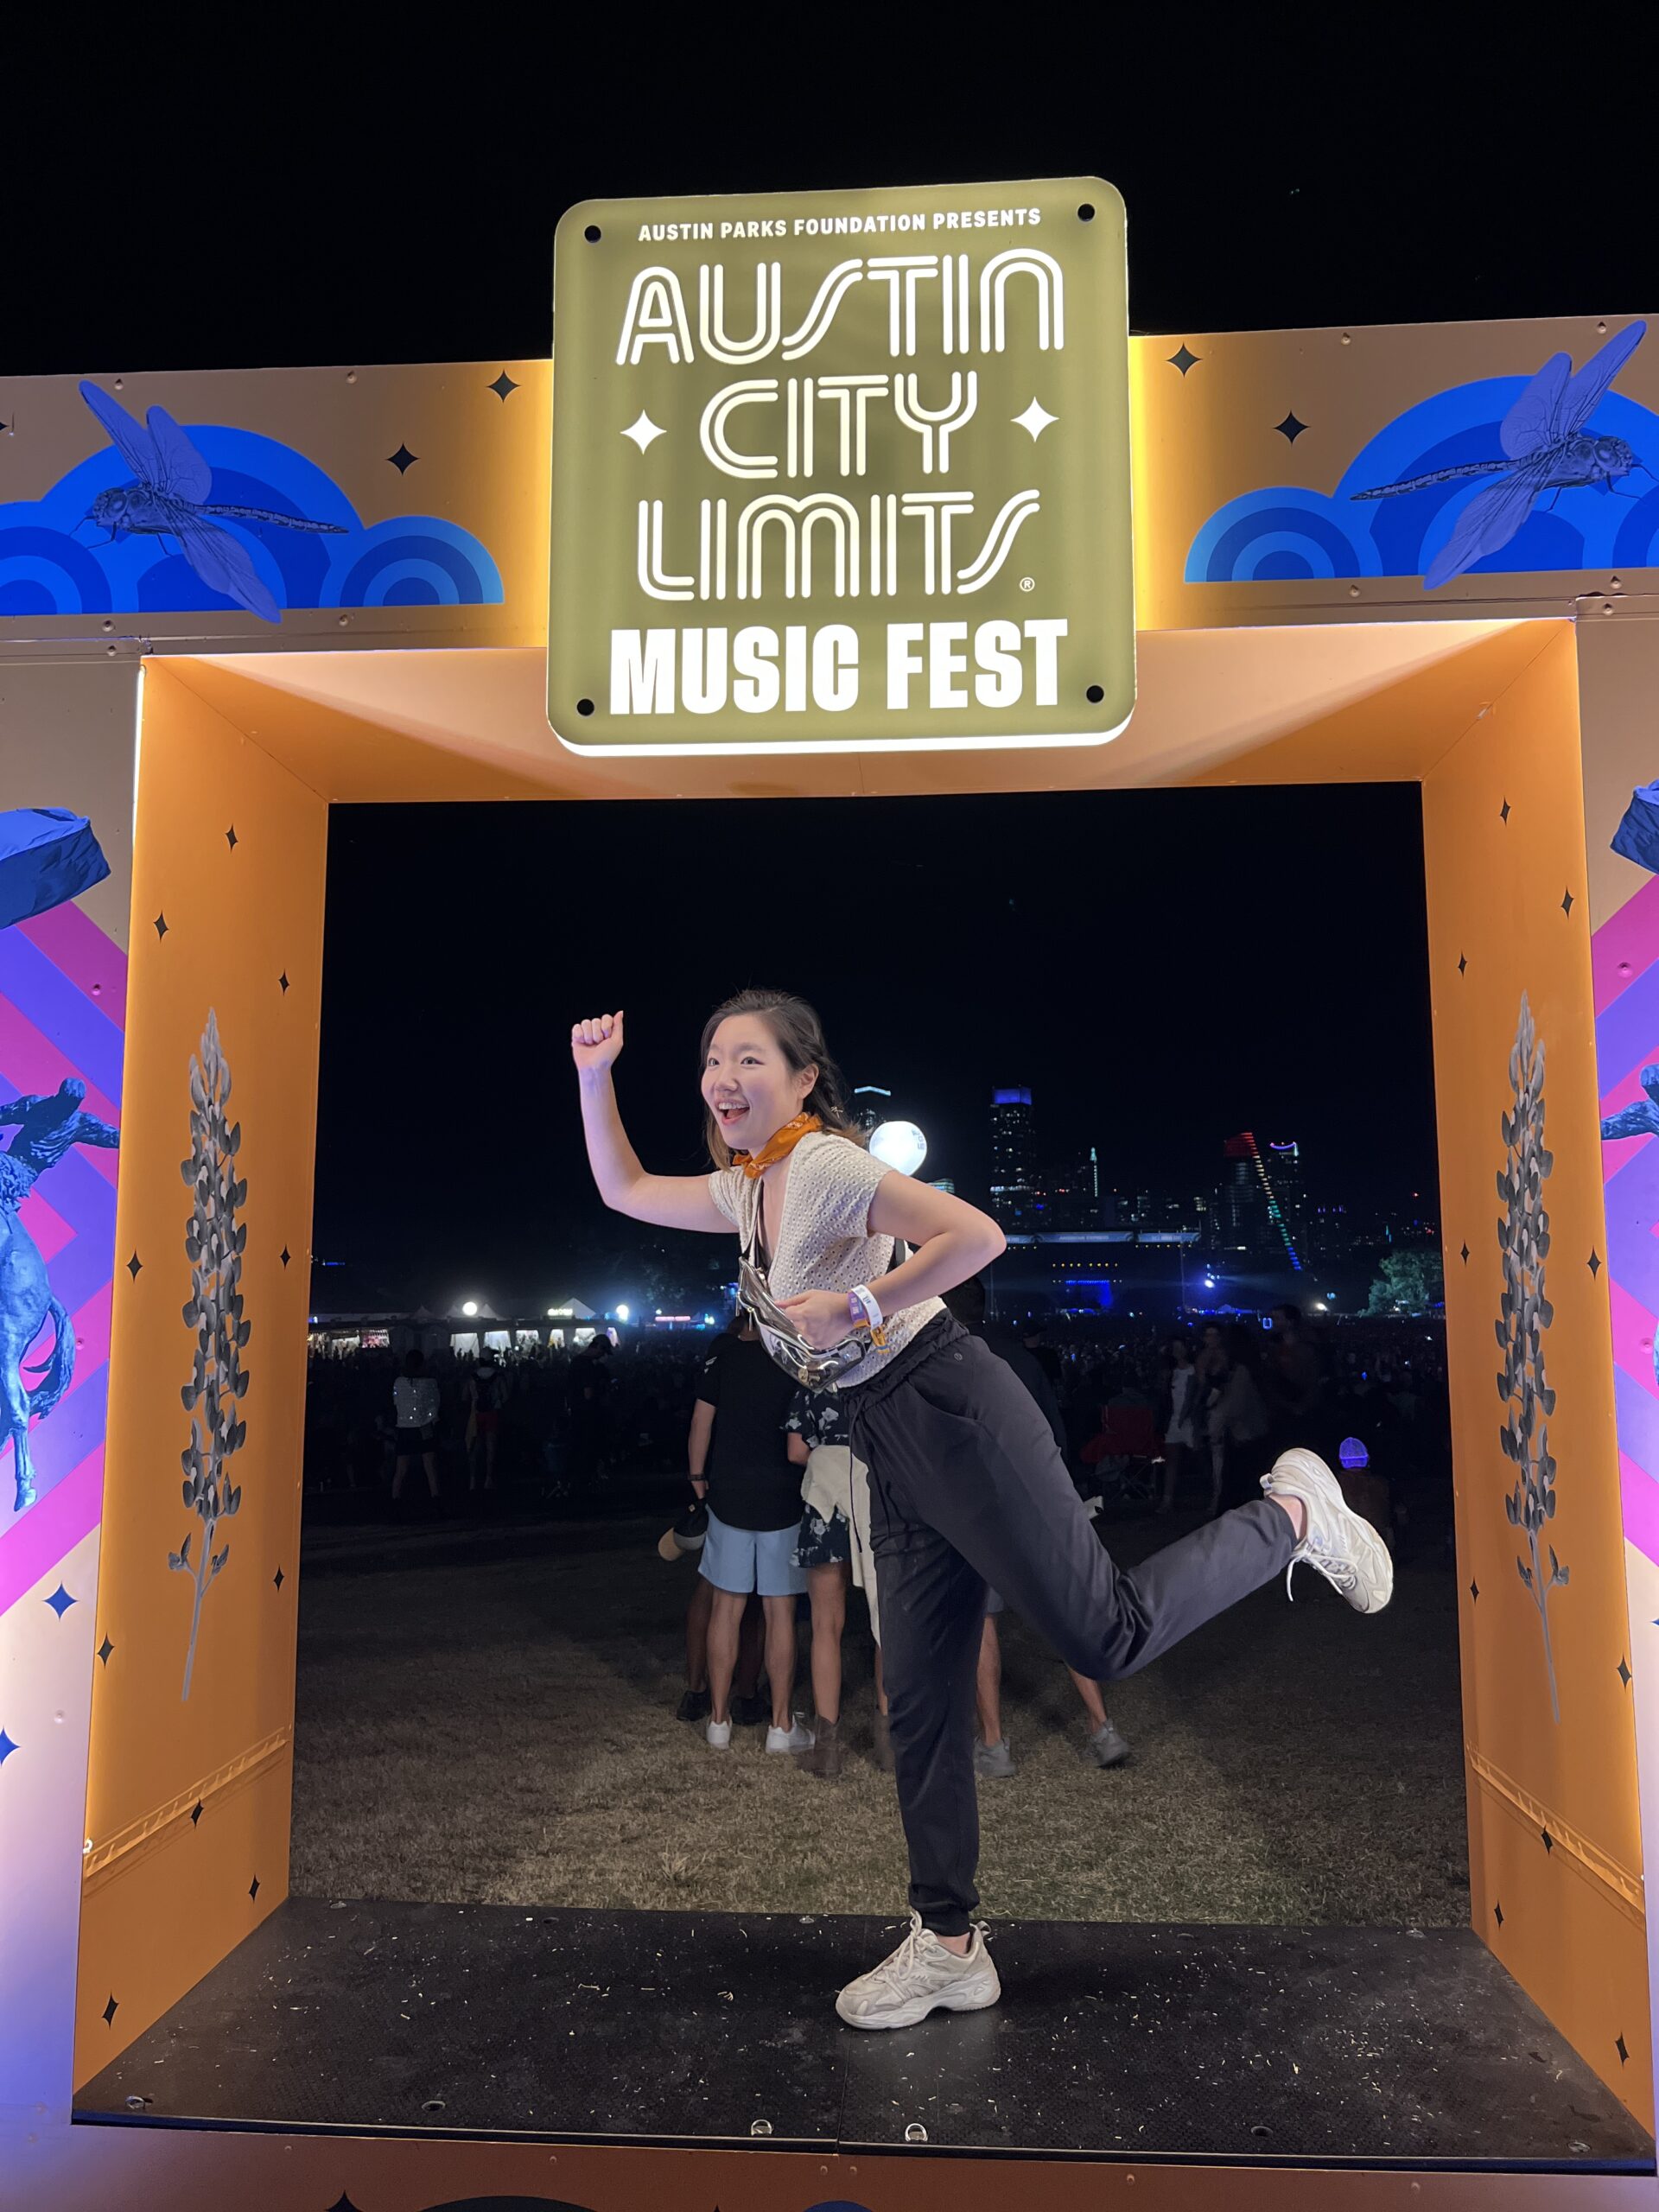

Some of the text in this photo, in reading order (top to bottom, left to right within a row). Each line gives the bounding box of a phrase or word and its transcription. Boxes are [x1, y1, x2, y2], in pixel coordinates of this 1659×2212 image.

[638, 207, 1041, 242] AUSTIN PARKS FOUNDATION PRESENTS
[615, 247, 1065, 365] AUSTIN
[699, 371, 977, 479] CITY
[638, 489, 1040, 601] LIMITS
[610, 619, 1068, 715] MUSIC FEST
